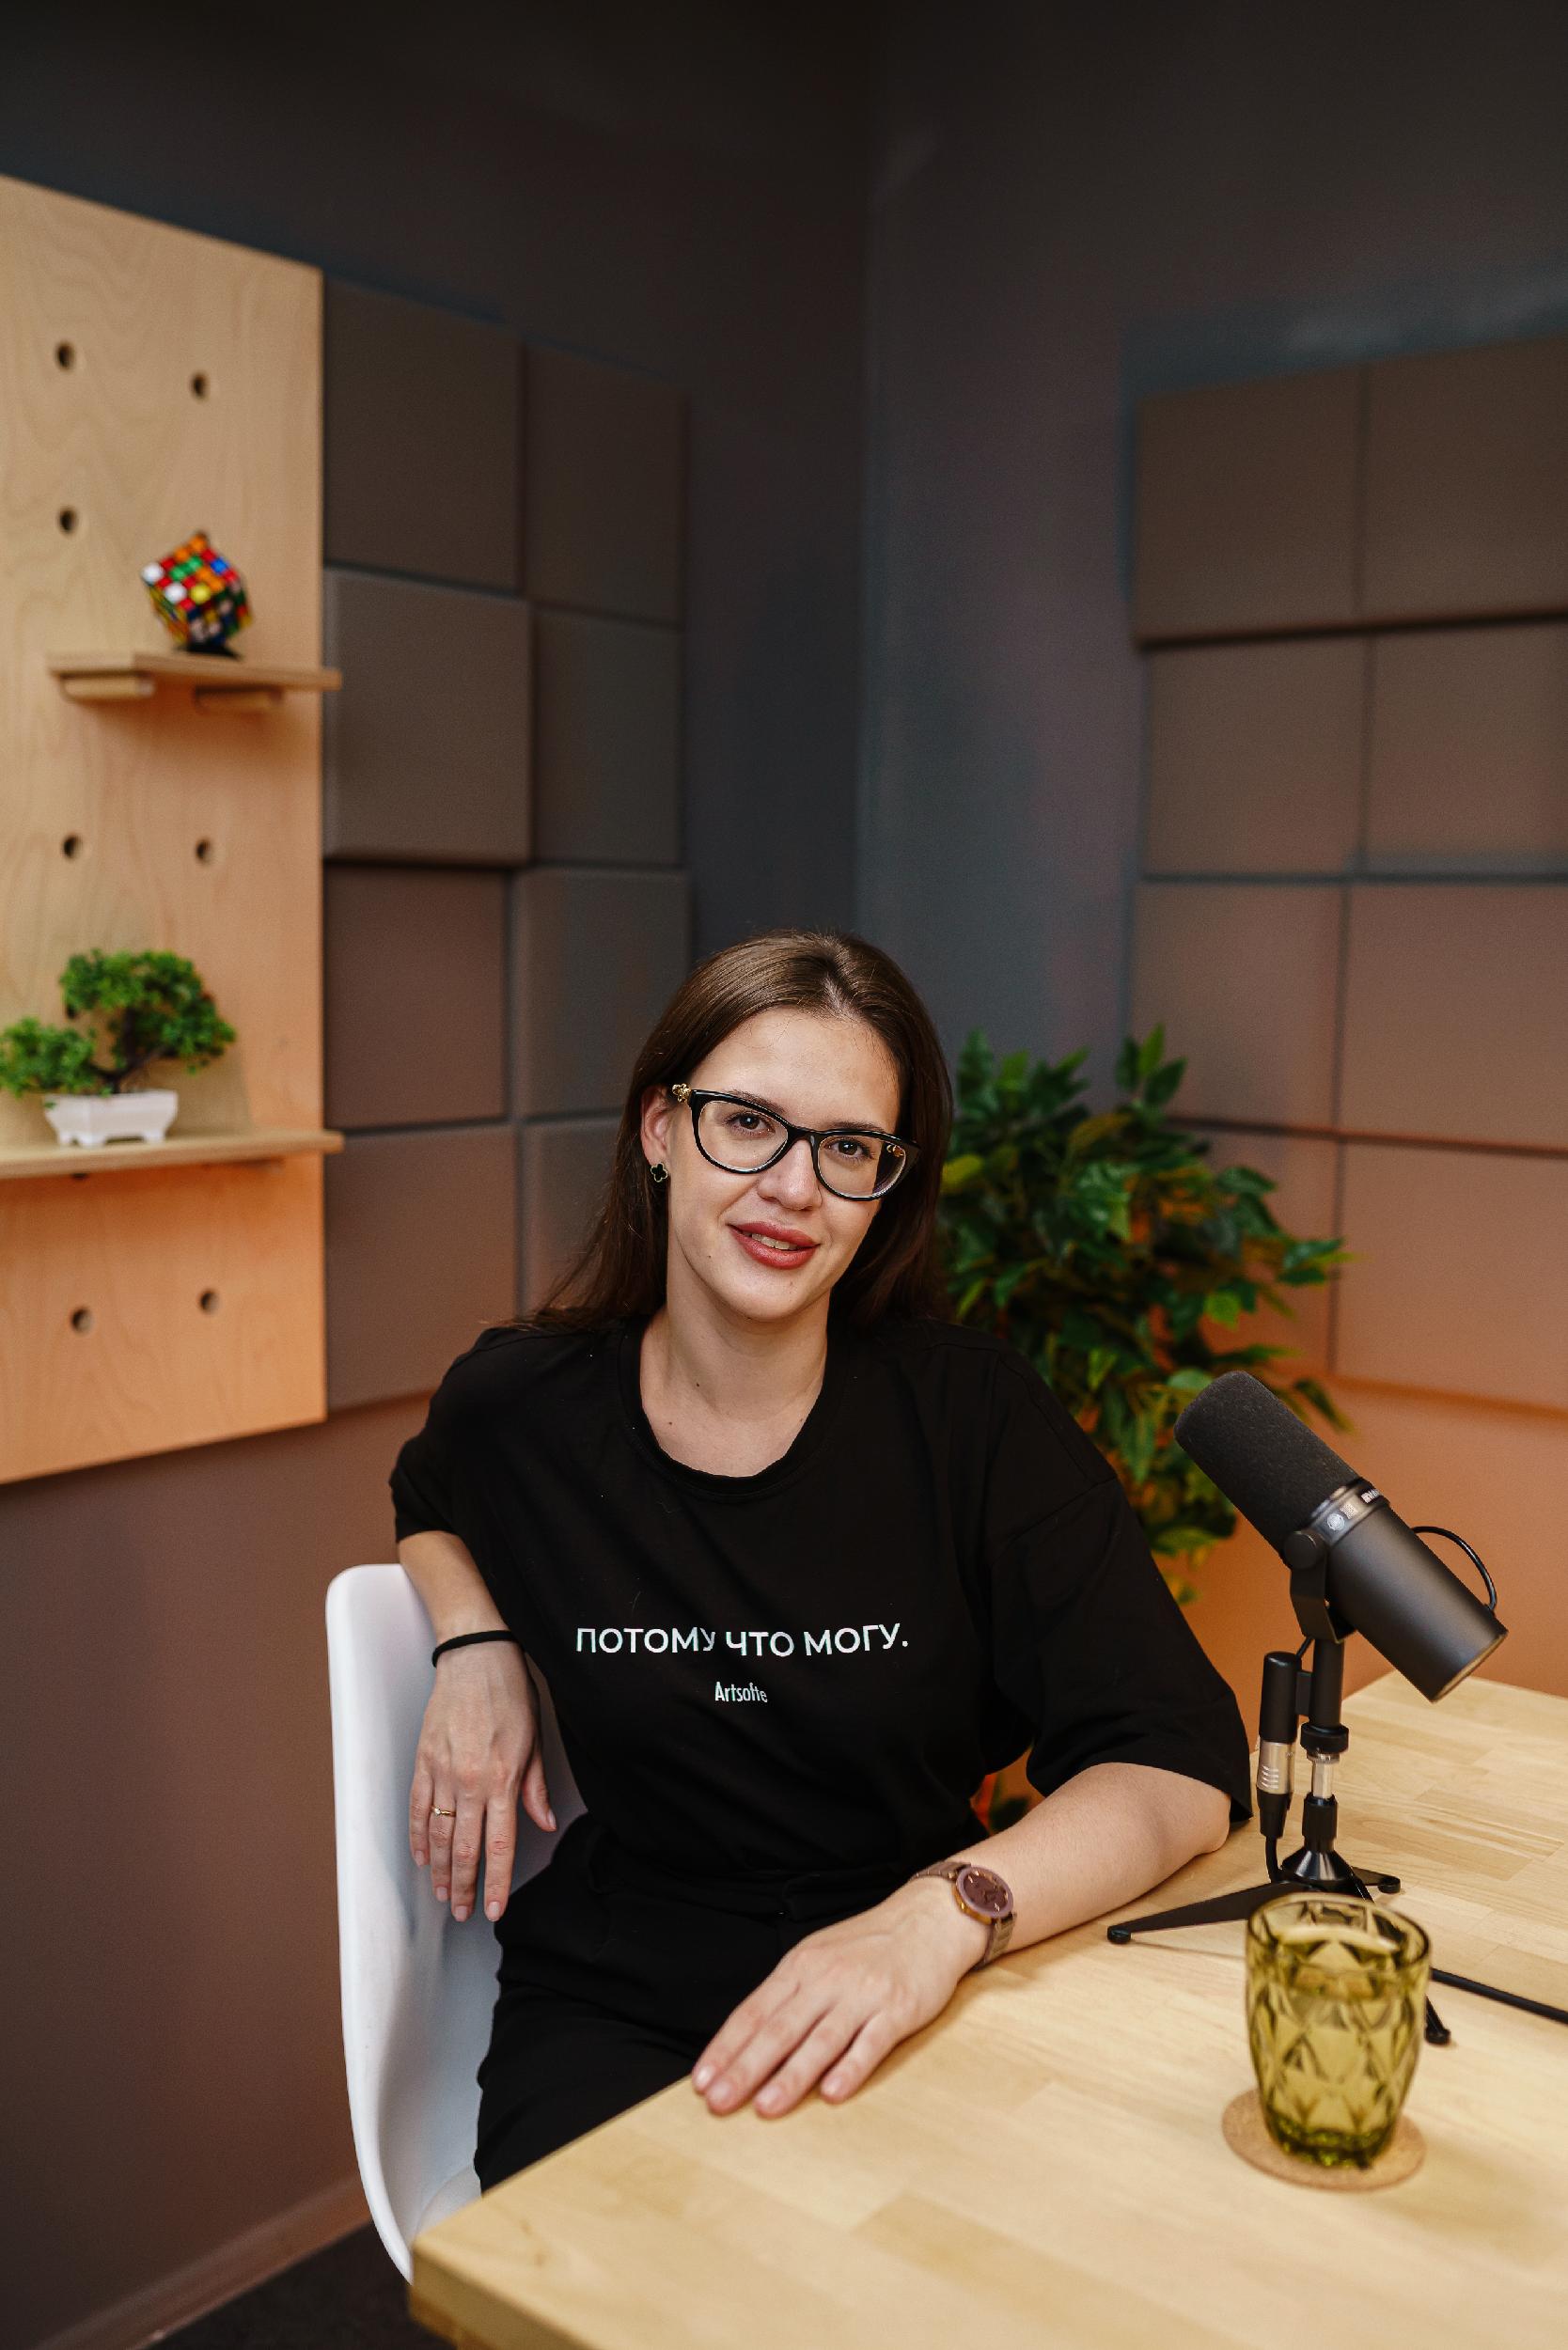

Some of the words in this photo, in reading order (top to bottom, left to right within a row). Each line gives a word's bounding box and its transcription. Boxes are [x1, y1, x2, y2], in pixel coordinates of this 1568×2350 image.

[576, 1627, 716, 1653] ПОТОМУ
[726, 1632, 795, 1657] ЧТО
[804, 1623, 909, 1656] МОГУ.
[714, 1681, 768, 1703] Artsofte
